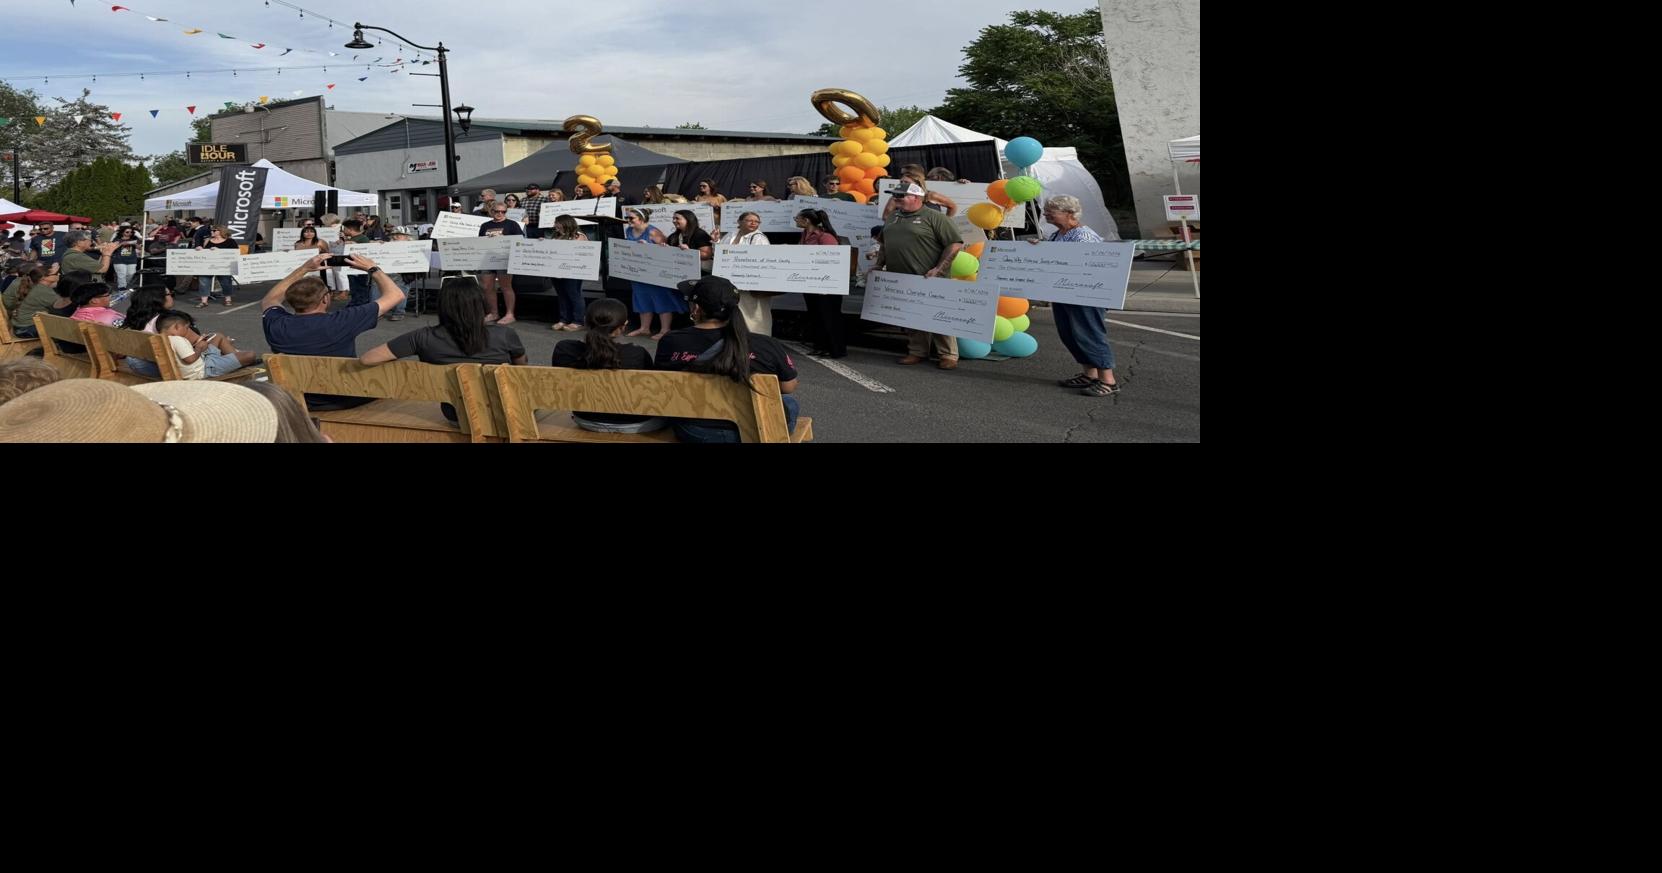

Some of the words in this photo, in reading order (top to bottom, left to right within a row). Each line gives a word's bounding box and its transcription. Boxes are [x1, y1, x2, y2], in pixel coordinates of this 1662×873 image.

[201, 144, 228, 152] IDLE
[227, 170, 257, 240] Microsoft
[291, 198, 316, 206] Micro
